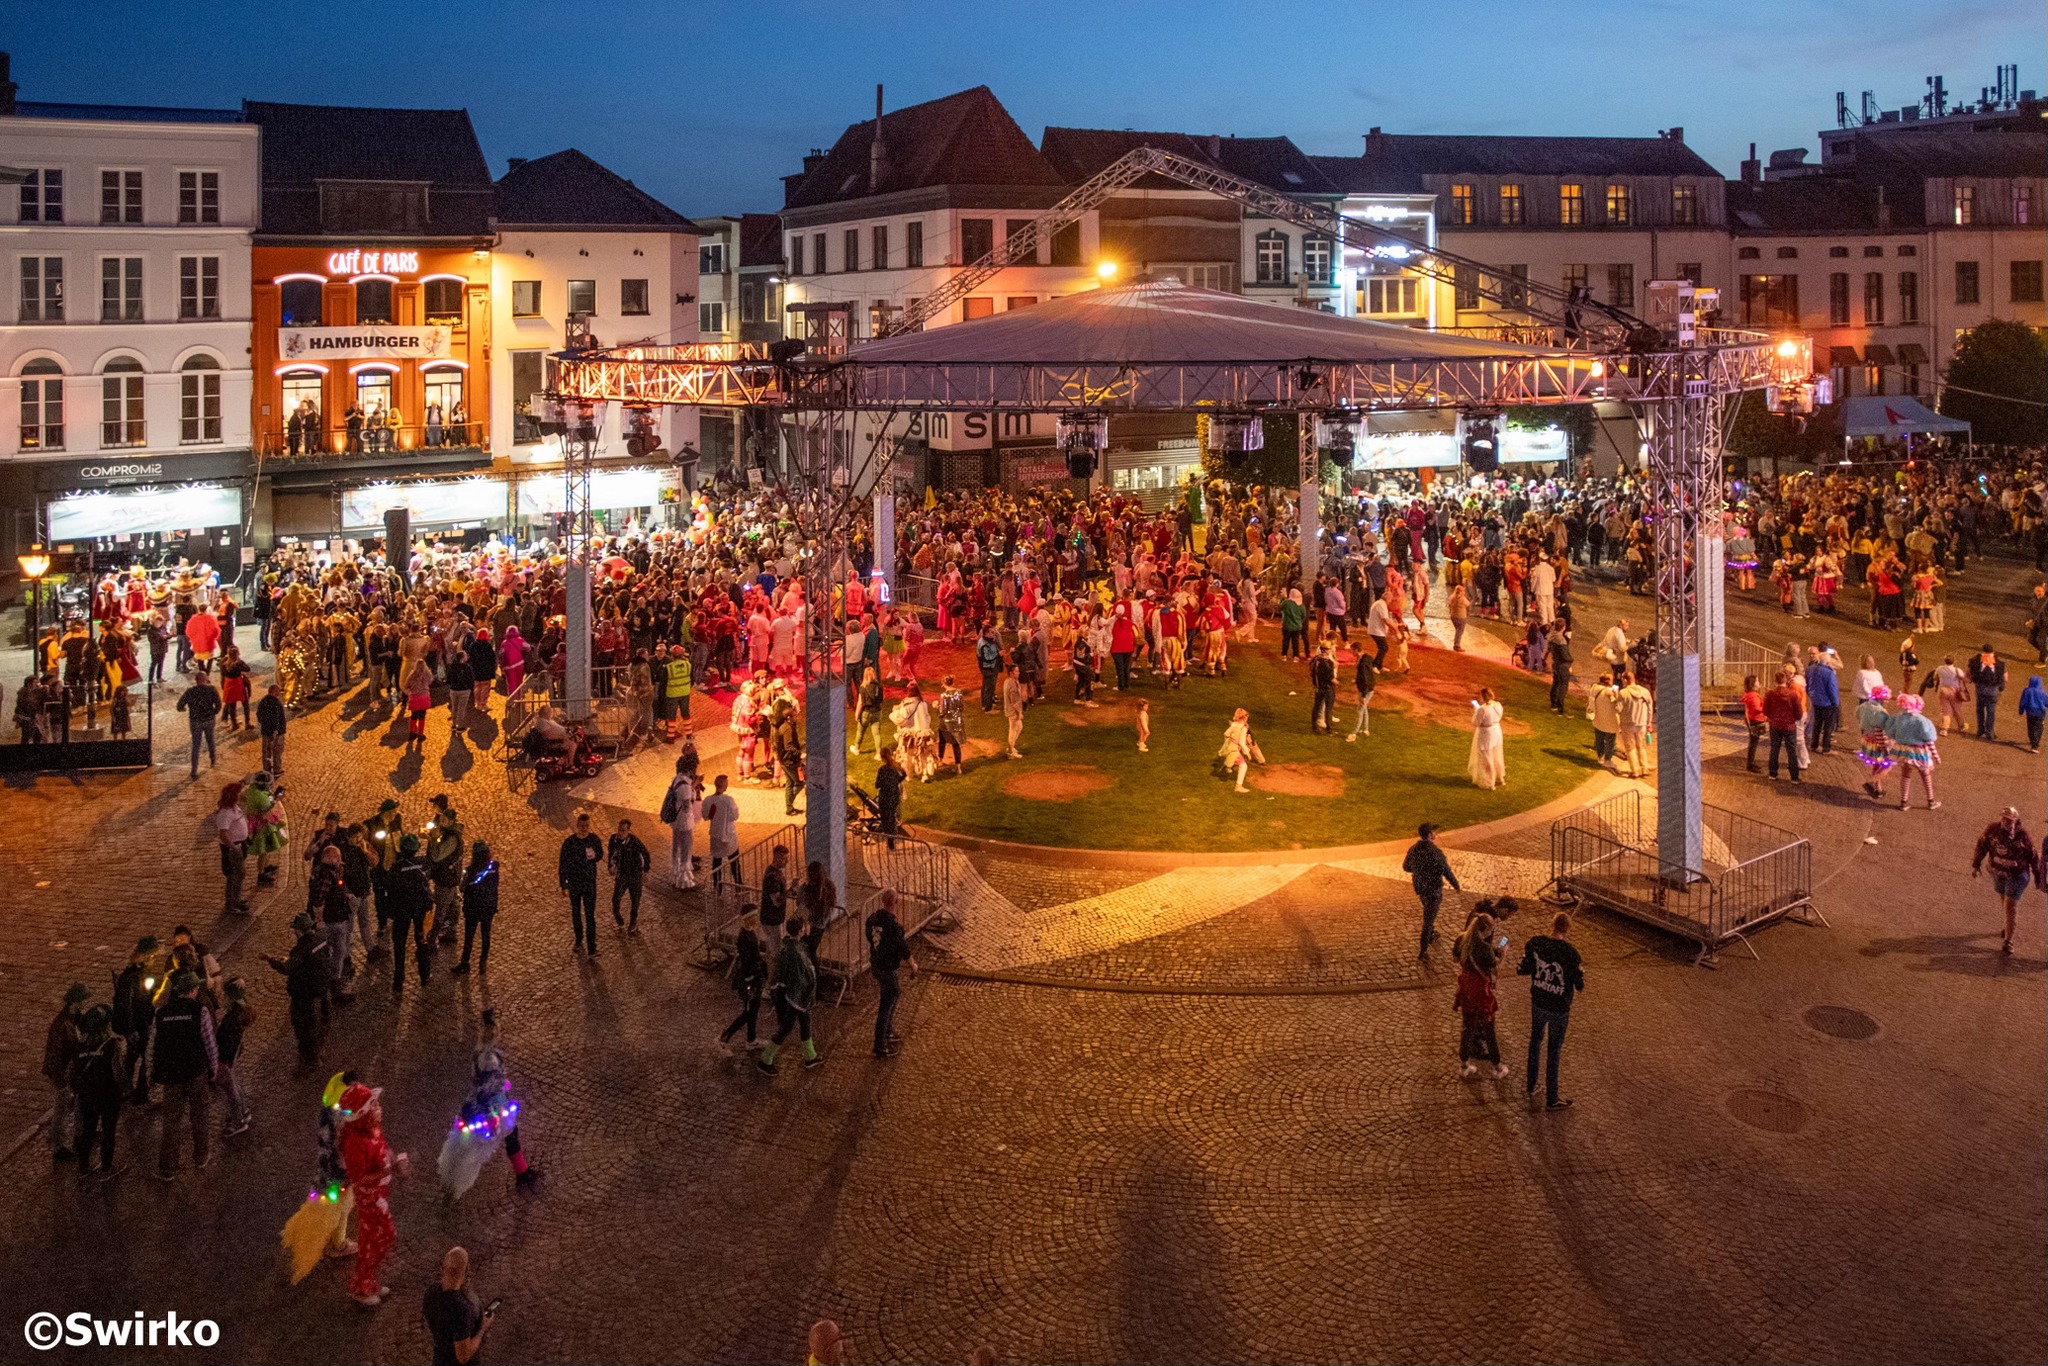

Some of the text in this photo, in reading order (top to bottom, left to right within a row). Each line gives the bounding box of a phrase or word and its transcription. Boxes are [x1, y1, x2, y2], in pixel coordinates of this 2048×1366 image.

[329, 249, 418, 274] CAFÉ DE PARIS
[309, 336, 419, 350] HAMBURGER
[1019, 470, 1069, 481] UITVERKOOP
